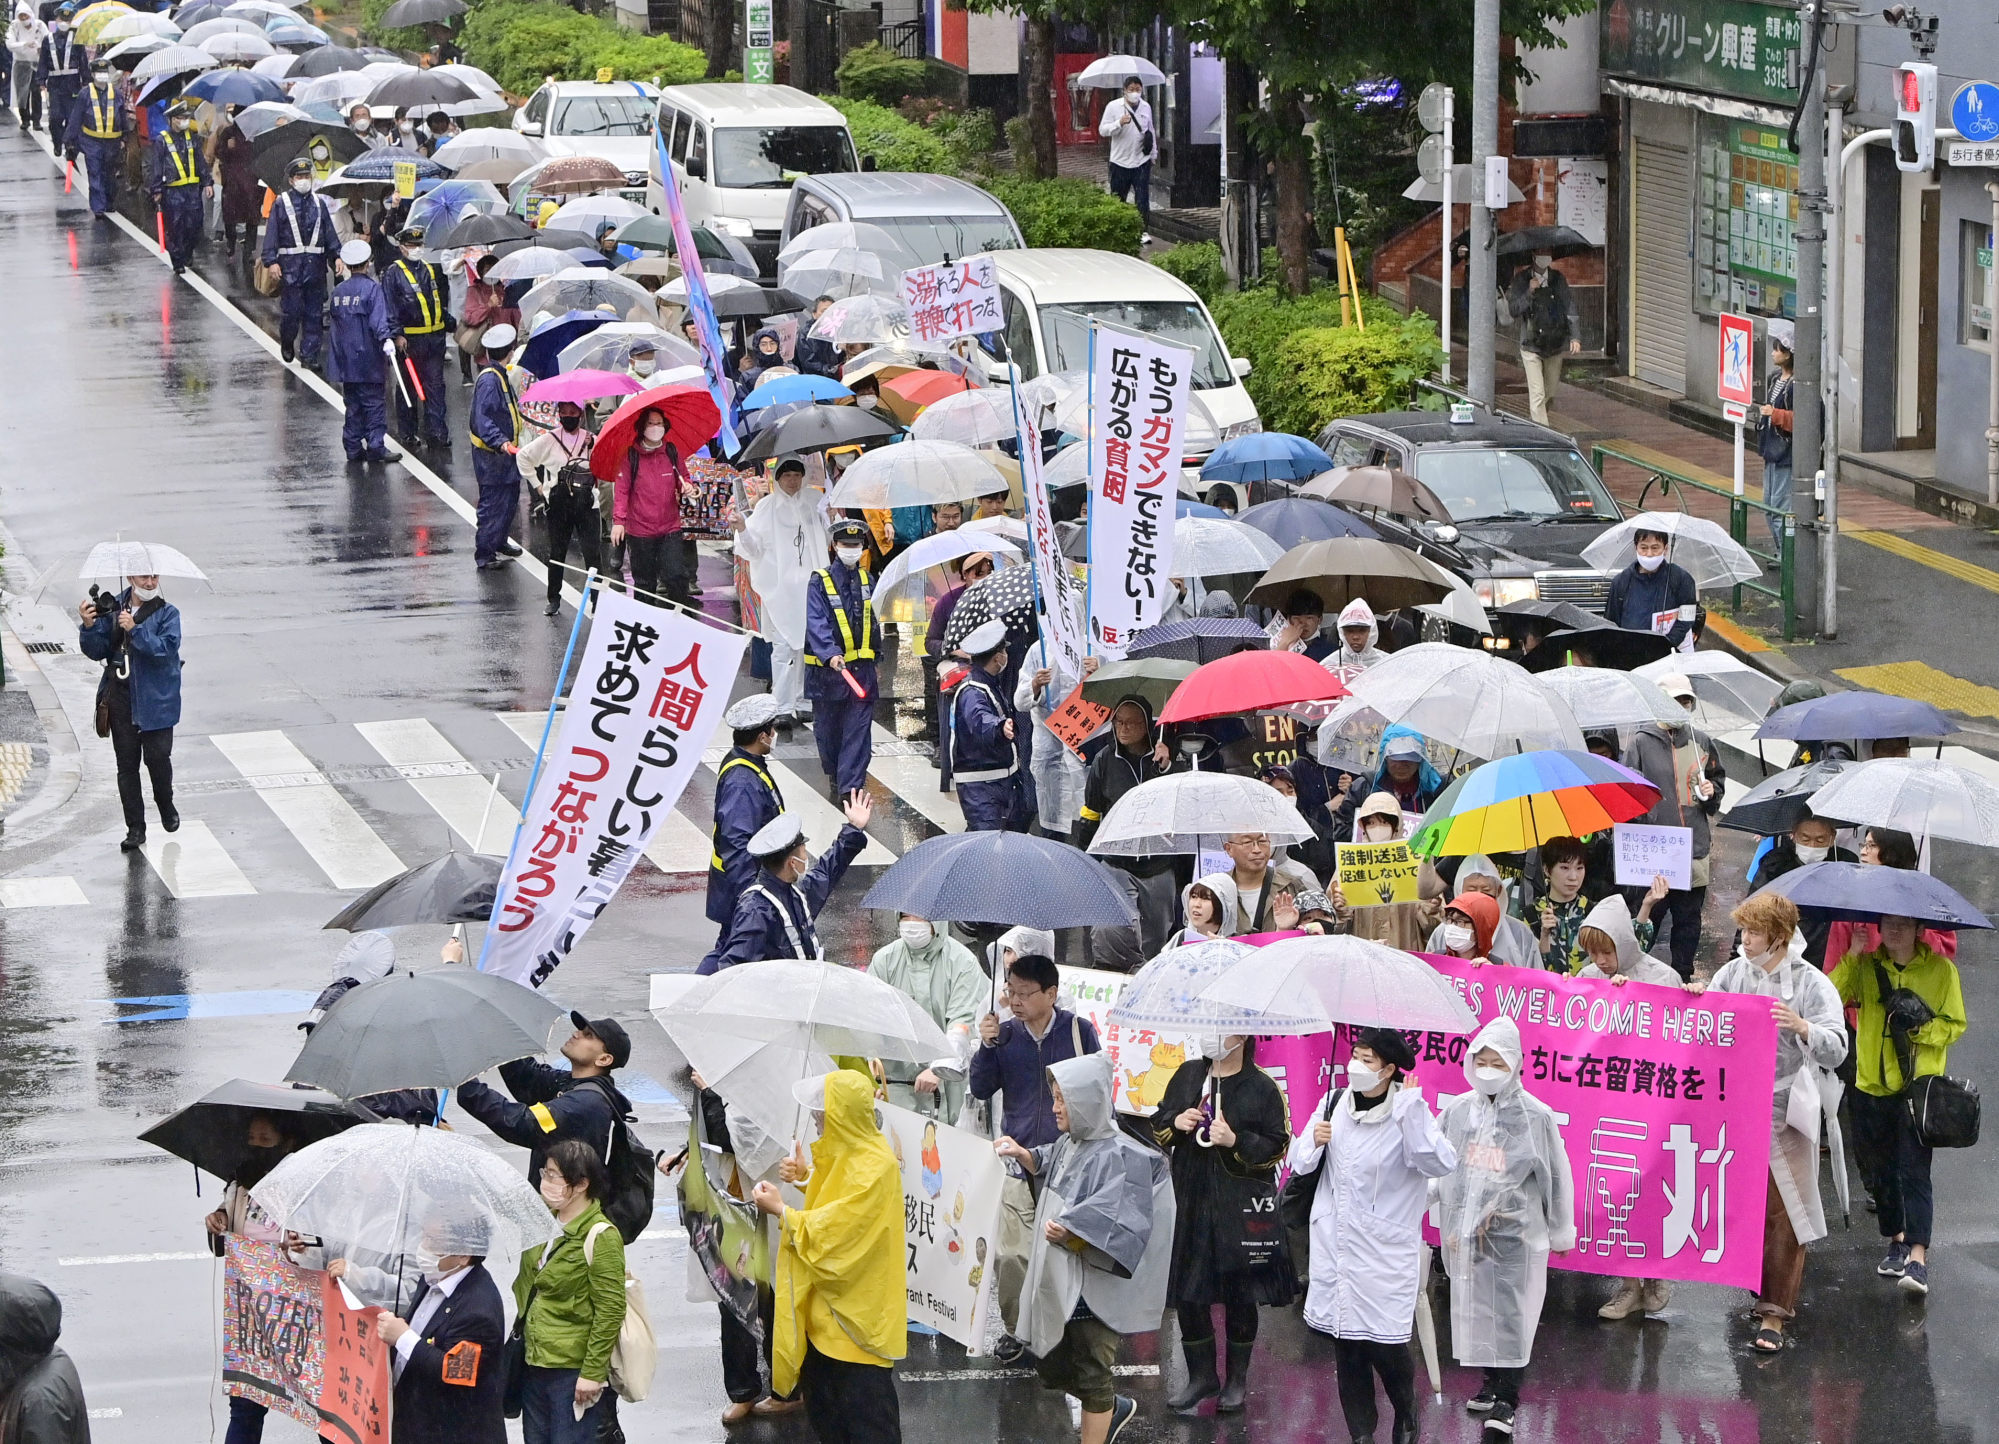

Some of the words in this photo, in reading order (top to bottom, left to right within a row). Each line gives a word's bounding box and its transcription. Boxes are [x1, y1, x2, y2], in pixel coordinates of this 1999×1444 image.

[1657, 12, 1757, 71] グリーン興産
[1765, 16, 1801, 42] 売買・仲介
[1952, 148, 1999, 161] 歩行者優
[905, 262, 996, 306] 溺れる人を
[911, 296, 999, 341] 鞭で打つな
[1102, 347, 1142, 505] 広がる貧困
[1125, 357, 1178, 621] もうガマンできない!
[498, 619, 660, 932] 求めてつながろう
[1622, 832, 1686, 846] 閉じこめるのも
[1622, 842, 1667, 855] 助けるのも
[1623, 852, 1649, 863] 私たち
[1495, 984, 1653, 1039] WELCOME
[1661, 1004, 1736, 1047] HERE
[927, 1292, 957, 1322] Festival
